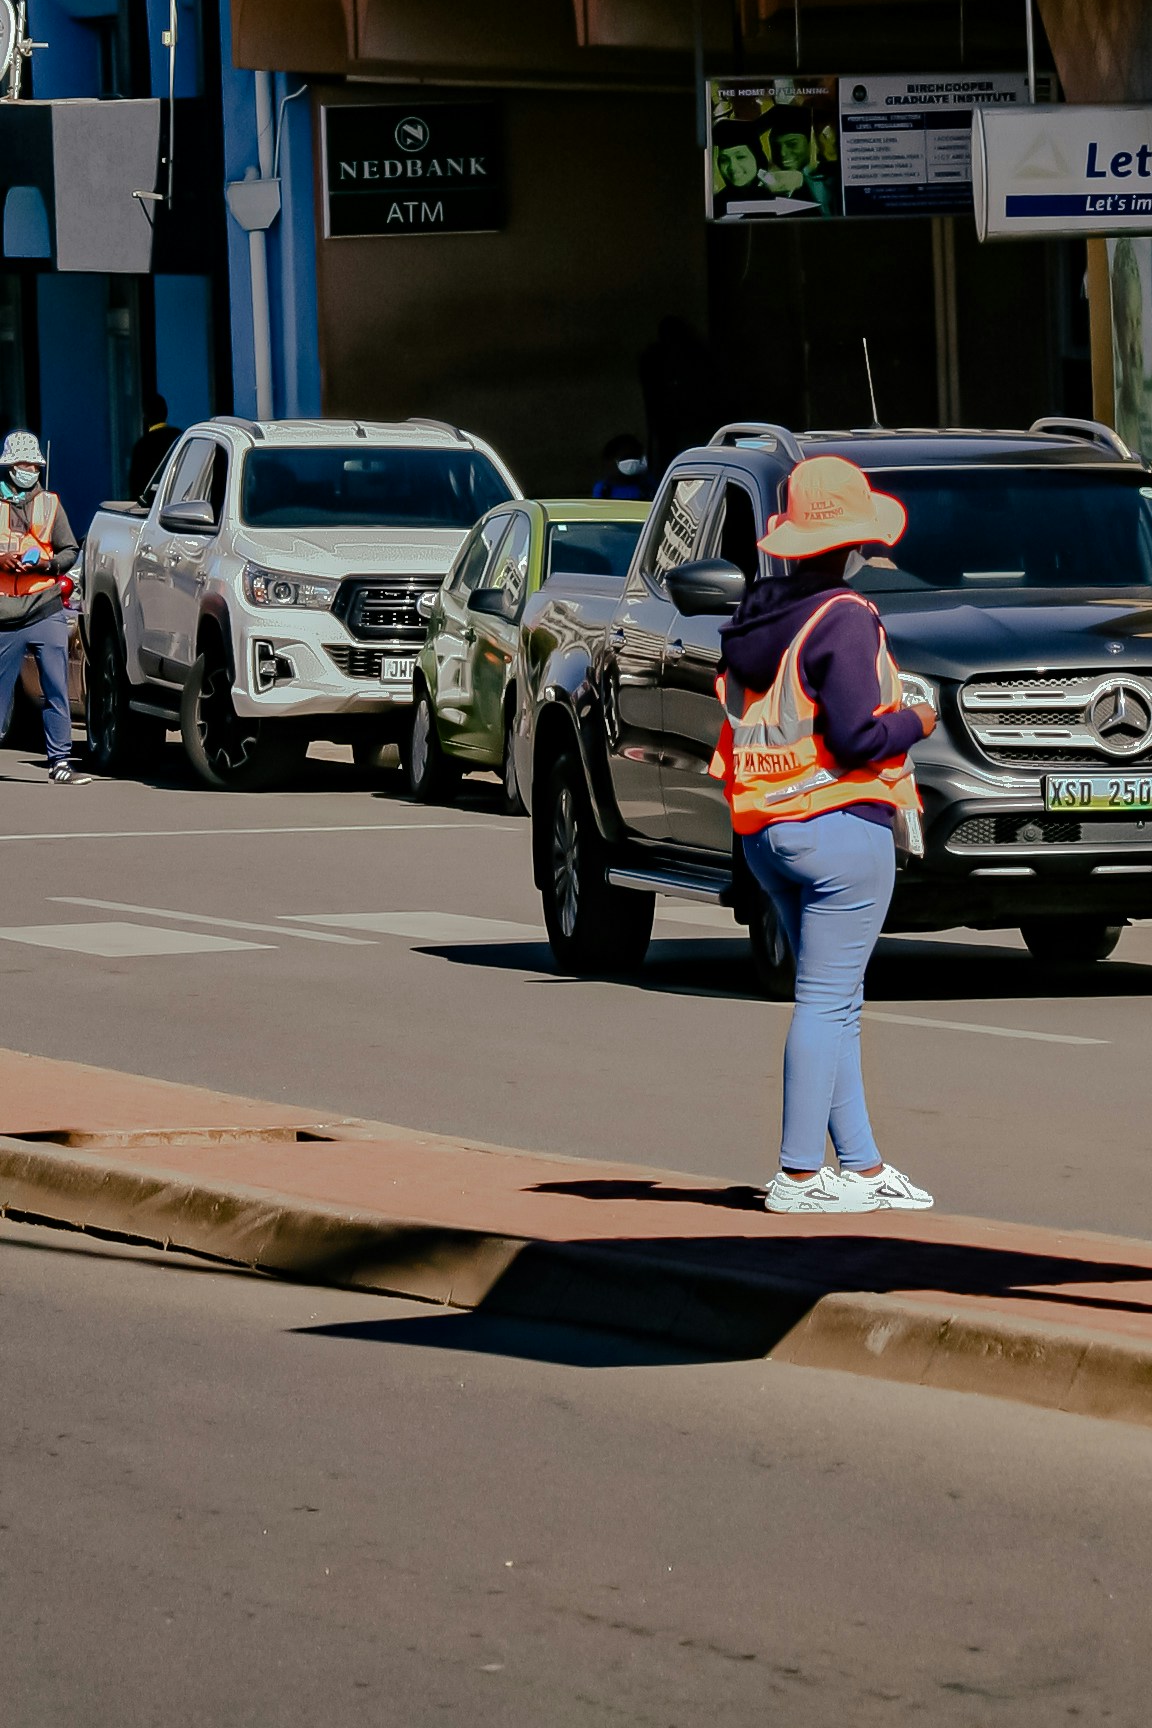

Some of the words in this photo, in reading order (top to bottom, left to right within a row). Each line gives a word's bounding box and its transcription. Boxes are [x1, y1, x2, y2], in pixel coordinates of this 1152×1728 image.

[906, 82, 994, 94] BIRCHCOOPER
[885, 94, 950, 106] GRADUATE
[953, 91, 1017, 103] INSTITUTE
[338, 157, 488, 179] NEDBANK
[387, 201, 444, 223] ATM
[1085, 195, 1126, 212] Let's
[1051, 780, 1092, 806] XSD
[1108, 780, 1151, 806] 250
